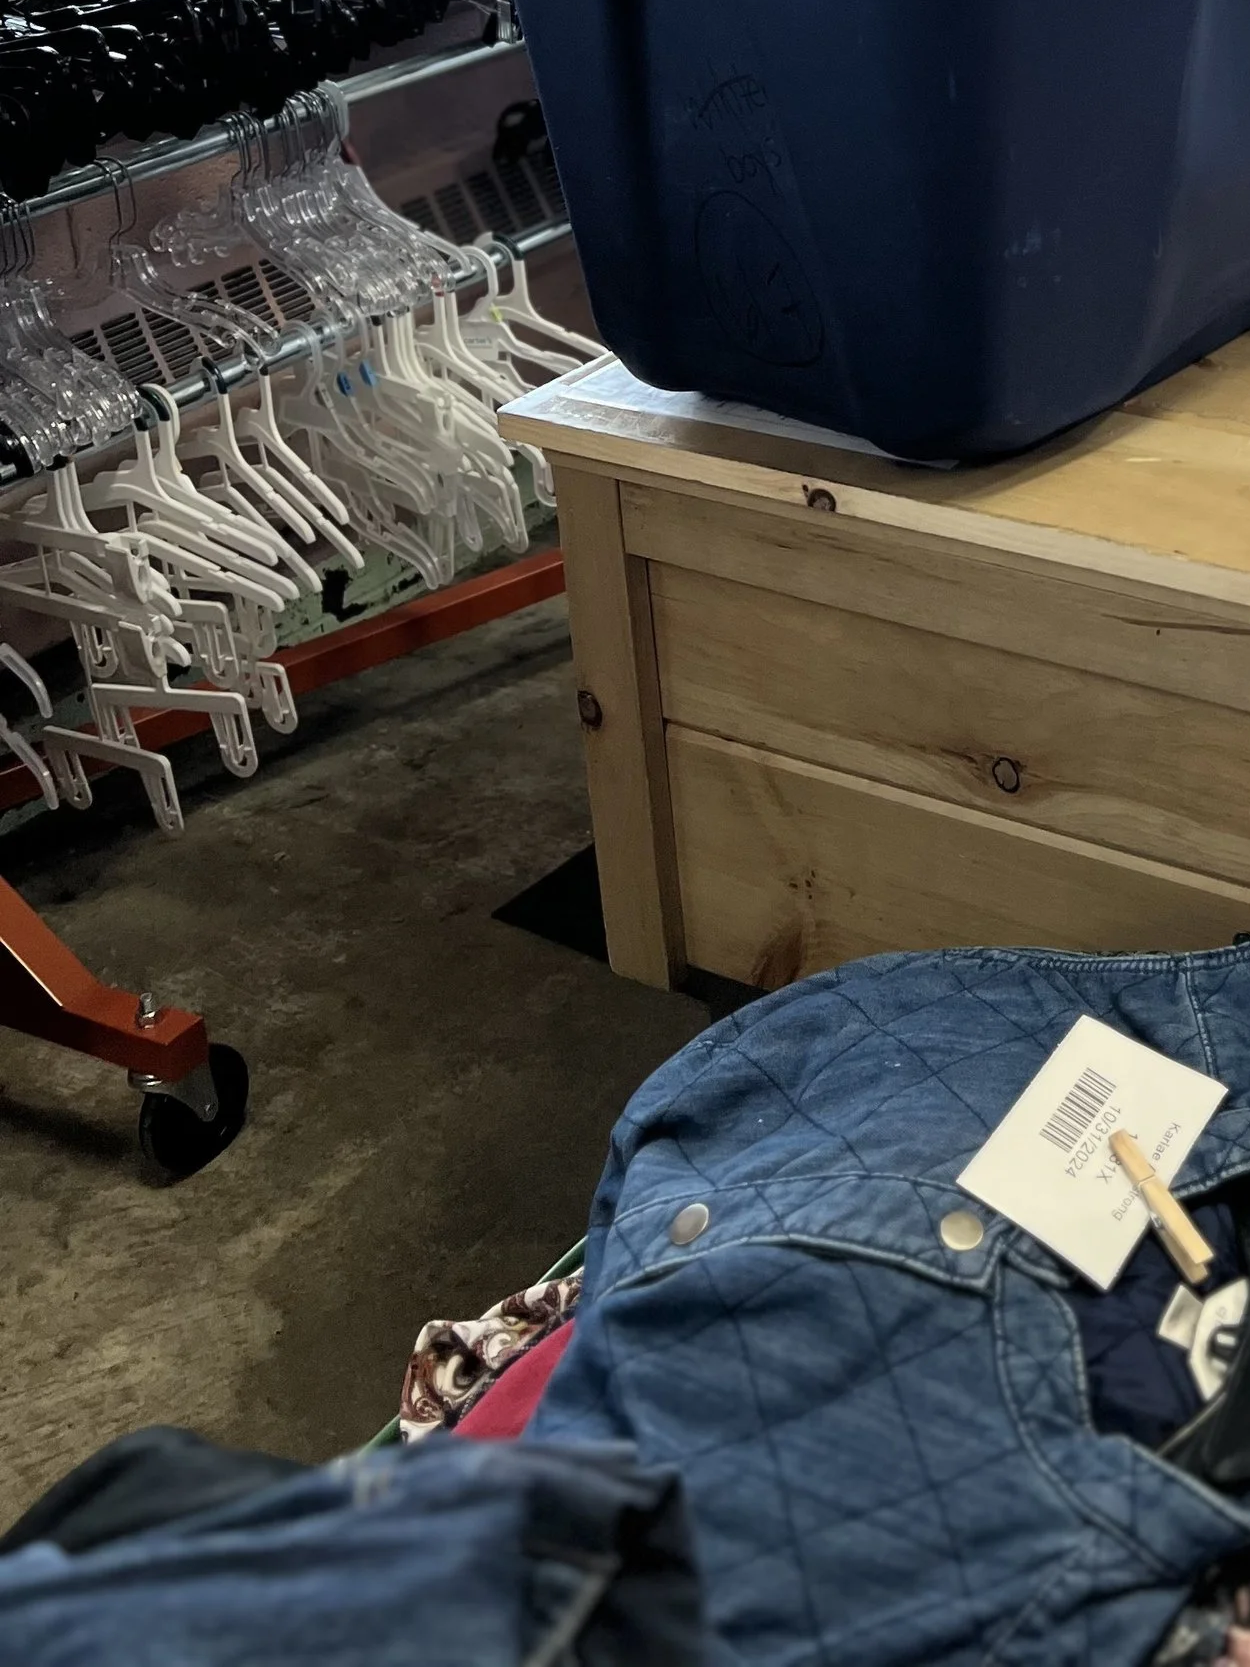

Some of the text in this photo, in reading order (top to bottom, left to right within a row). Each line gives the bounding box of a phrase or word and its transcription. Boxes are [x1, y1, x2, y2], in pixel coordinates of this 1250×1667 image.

[1064, 1105, 1121, 1179] 10/31/2024
[1096, 1133, 1139, 1184] 181X
[1152, 1122, 1182, 1161] Karlae
